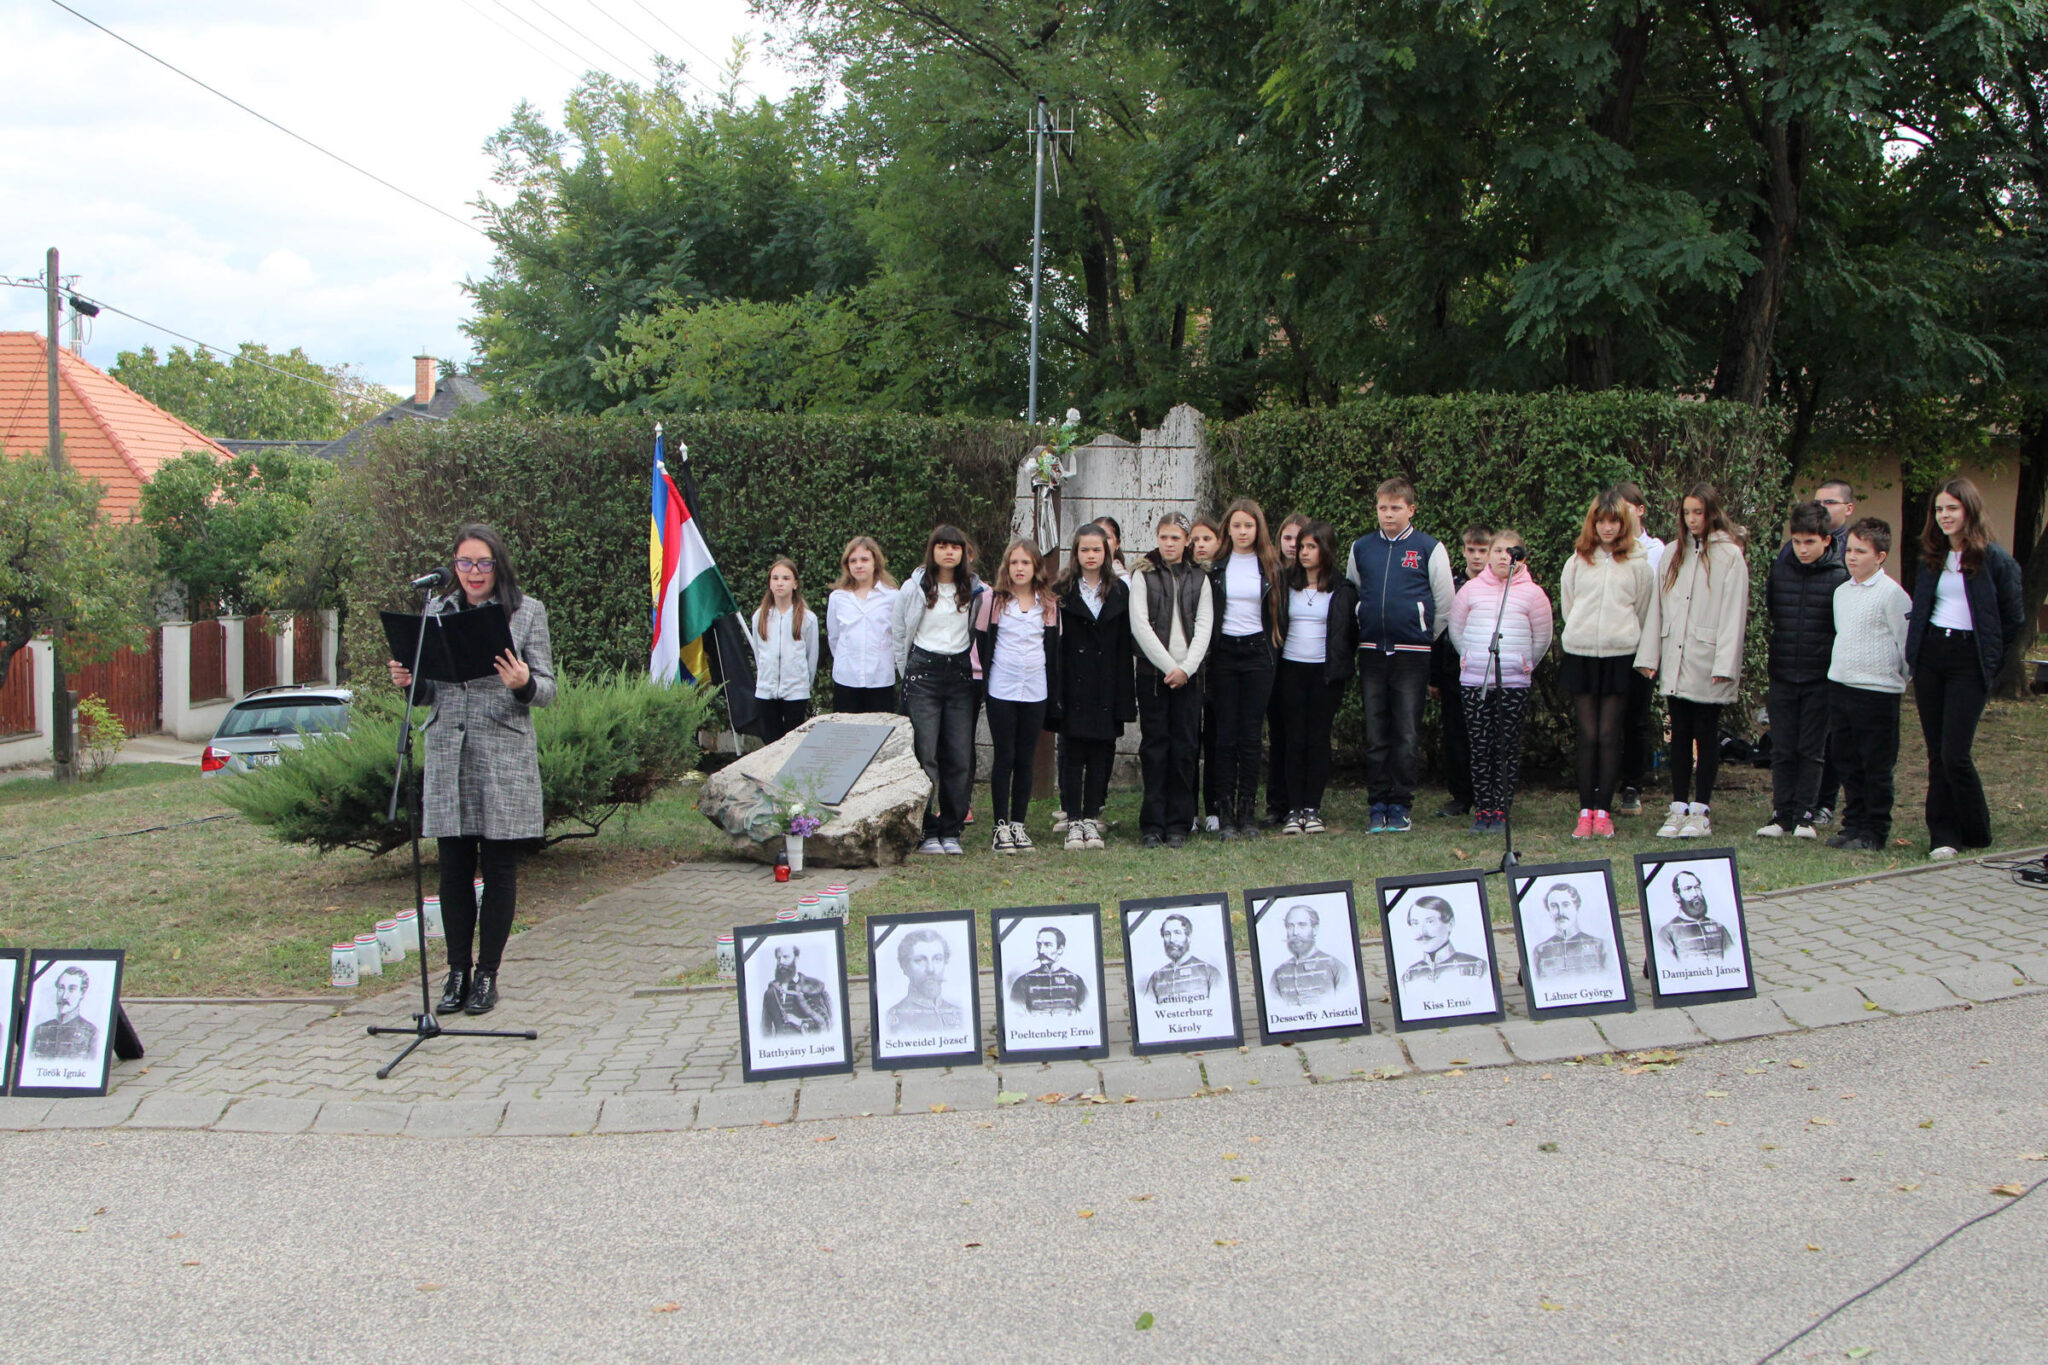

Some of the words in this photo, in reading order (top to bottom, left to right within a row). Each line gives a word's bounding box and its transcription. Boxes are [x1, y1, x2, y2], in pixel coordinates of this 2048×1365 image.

[1402, 551, 1418, 568] A
[1661, 967, 1713, 980] Damjanich
[1715, 965, 1741, 978] János
[1544, 991, 1578, 1002] Láhner
[1580, 988, 1614, 999] György
[1423, 1000, 1445, 1010] Kiss
[1154, 1008, 1213, 1019] Westerburg
[1270, 1011, 1317, 1024] Dessewffy
[1321, 1007, 1358, 1019] Arisztid
[1010, 1028, 1068, 1040] Poeltenberg
[1168, 1022, 1202, 1034] Károly
[885, 1036, 936, 1049] Schweidel
[938, 1034, 969, 1048] József
[758, 1046, 807, 1059] Batthyány
[809, 1043, 835, 1056] Lajos
[36, 1066, 62, 1078] Török
[63, 1066, 87, 1080] Ignác
